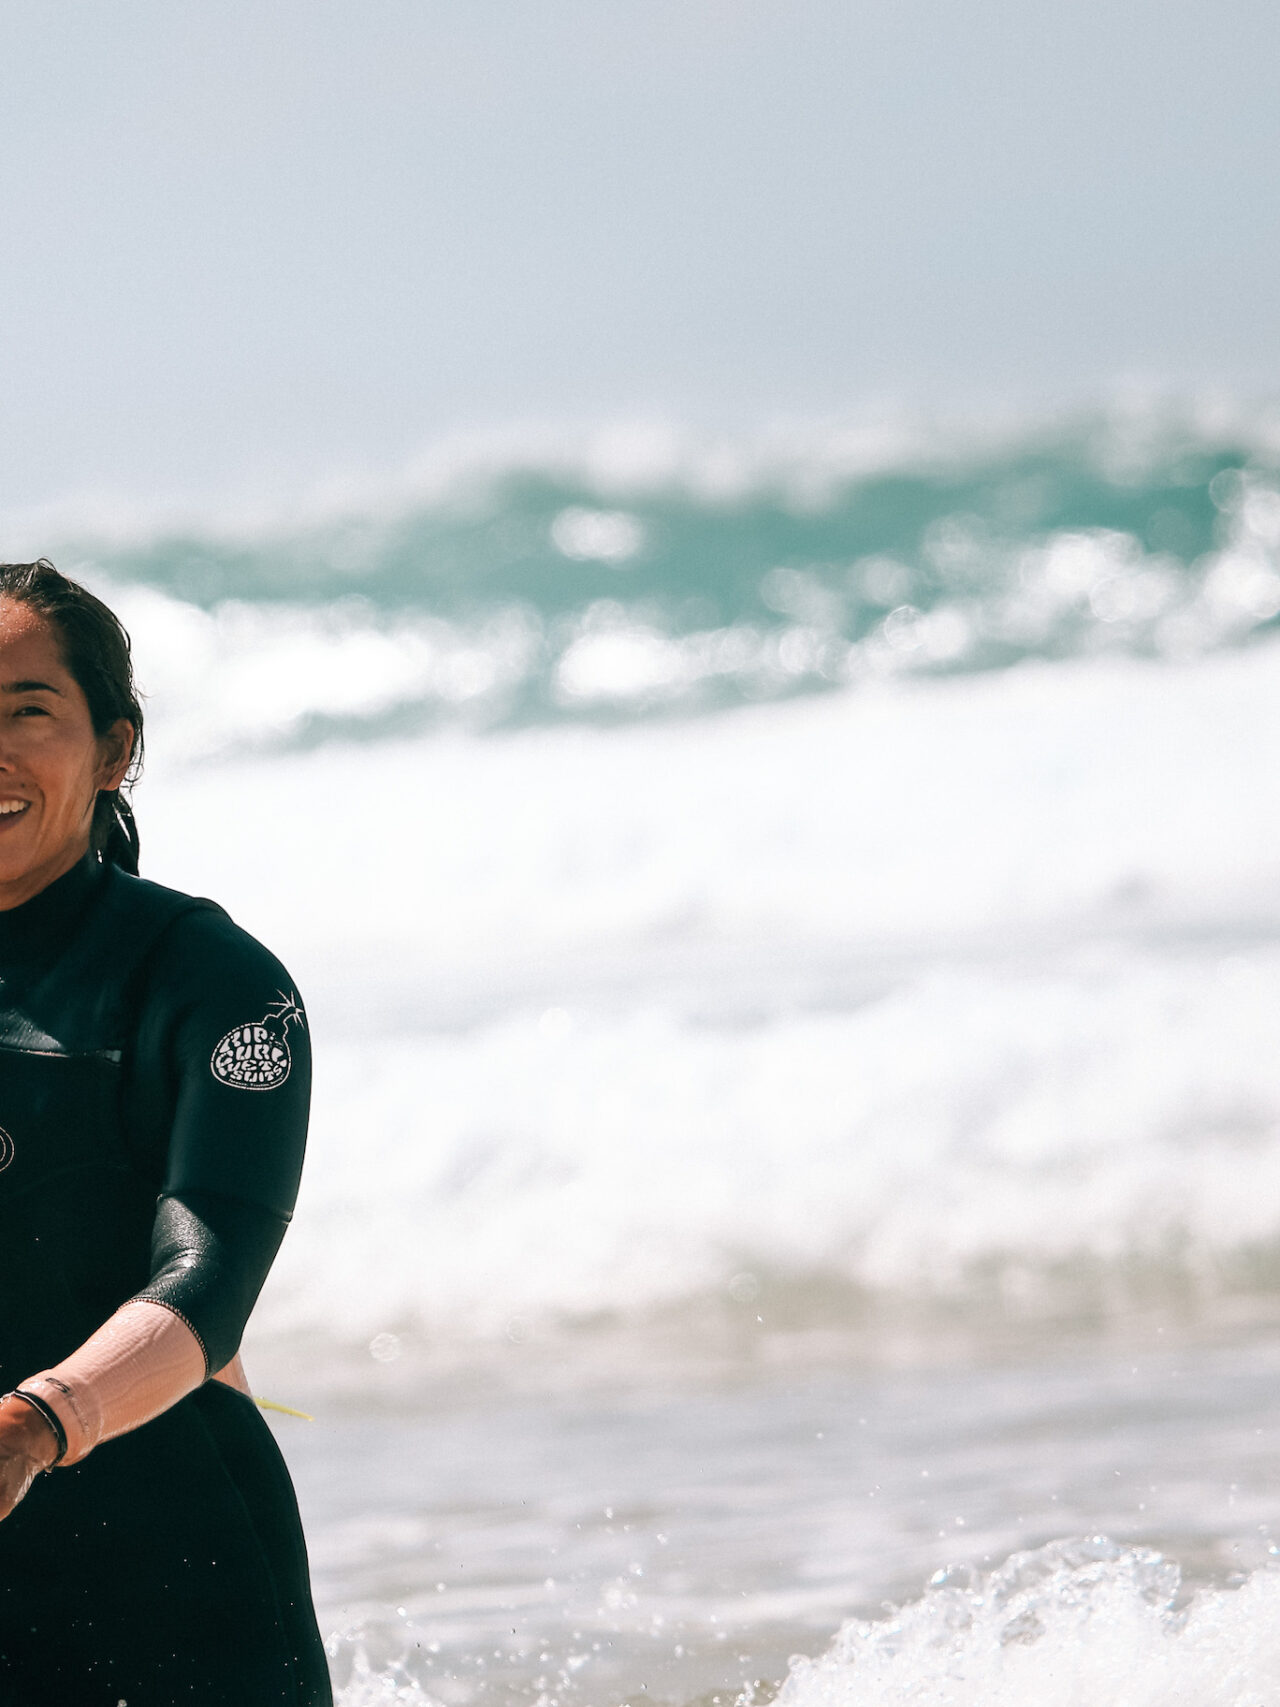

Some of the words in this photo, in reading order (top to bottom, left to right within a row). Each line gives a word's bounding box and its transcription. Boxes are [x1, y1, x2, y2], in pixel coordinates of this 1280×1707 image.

[219, 1027, 268, 1053] RIP
[216, 1044, 288, 1068] CURL
[230, 1065, 283, 1082] SUITS
